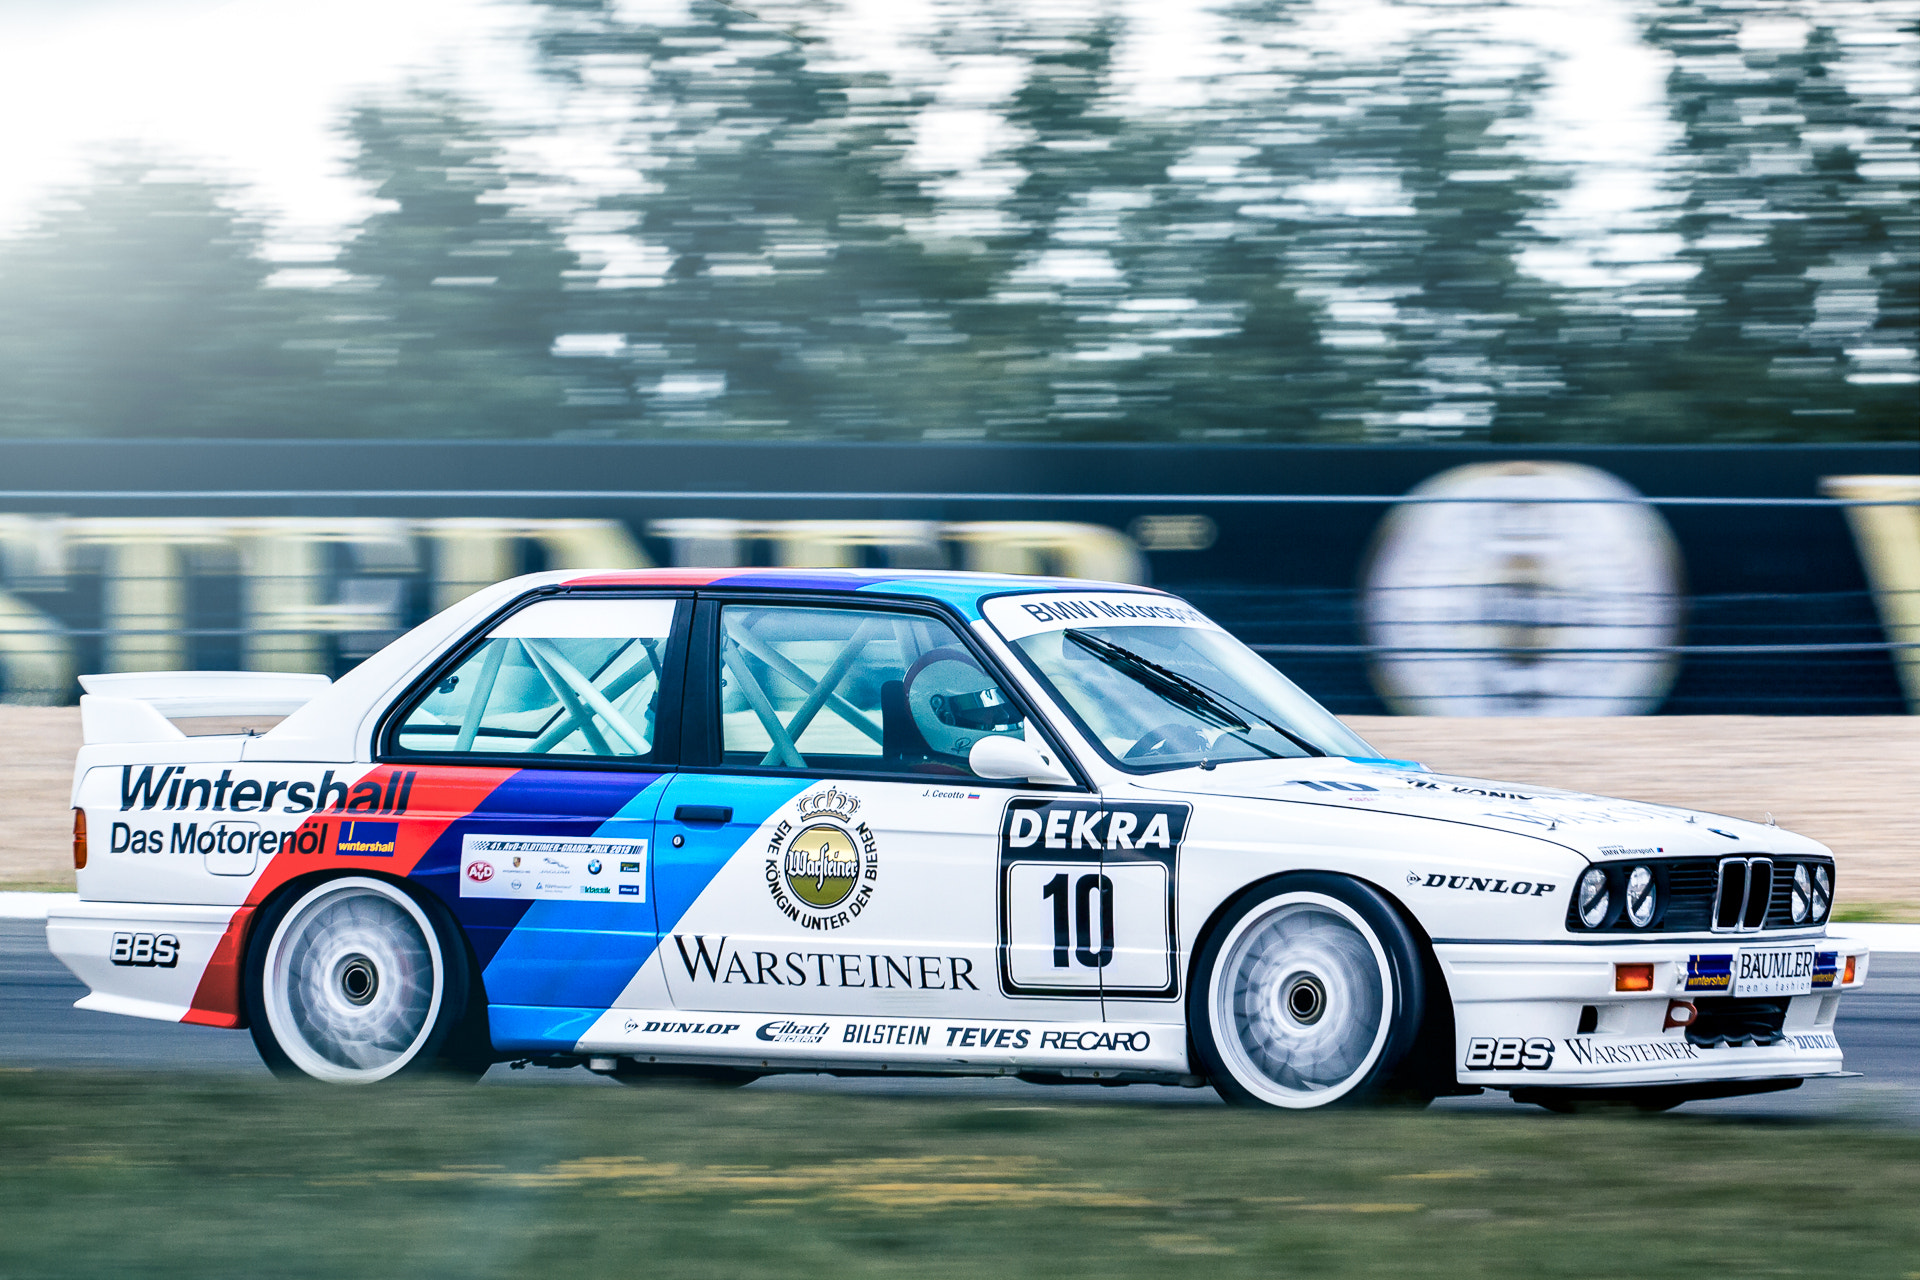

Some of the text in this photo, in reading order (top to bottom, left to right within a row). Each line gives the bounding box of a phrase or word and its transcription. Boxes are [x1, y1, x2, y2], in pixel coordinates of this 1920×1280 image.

[1021, 601, 1211, 625] BMW Motorsport
[119, 765, 417, 815] Wintershall
[922, 789, 965, 799] J. Cecotto
[110, 822, 329, 855] Das Motorenöl
[1009, 809, 1171, 850] DEKRA
[338, 841, 395, 852] wintershall
[766, 820, 878, 931] EINE KÖNIGIN UNTER DEN BIEREN
[1422, 874, 1556, 897] DUNLOP
[1043, 873, 1114, 968] 10
[110, 931, 180, 968] BBS
[673, 934, 979, 991] WARSTEINER
[1739, 951, 1812, 979] BÄUMLER
[1688, 974, 1731, 986] wintershall
[1737, 980, 1810, 992] men's fashion
[642, 1021, 740, 1034] DUNLOP
[755, 1021, 830, 1042] Eibach
[843, 1024, 931, 1045] BILSTEIN
[946, 1027, 1031, 1048] TEVES
[1040, 1031, 1150, 1051] RECARO
[1563, 1038, 1699, 1065] WARSTEINER
[1794, 1034, 1839, 1049] DUNLO
[1465, 1037, 1555, 1070] BBS
